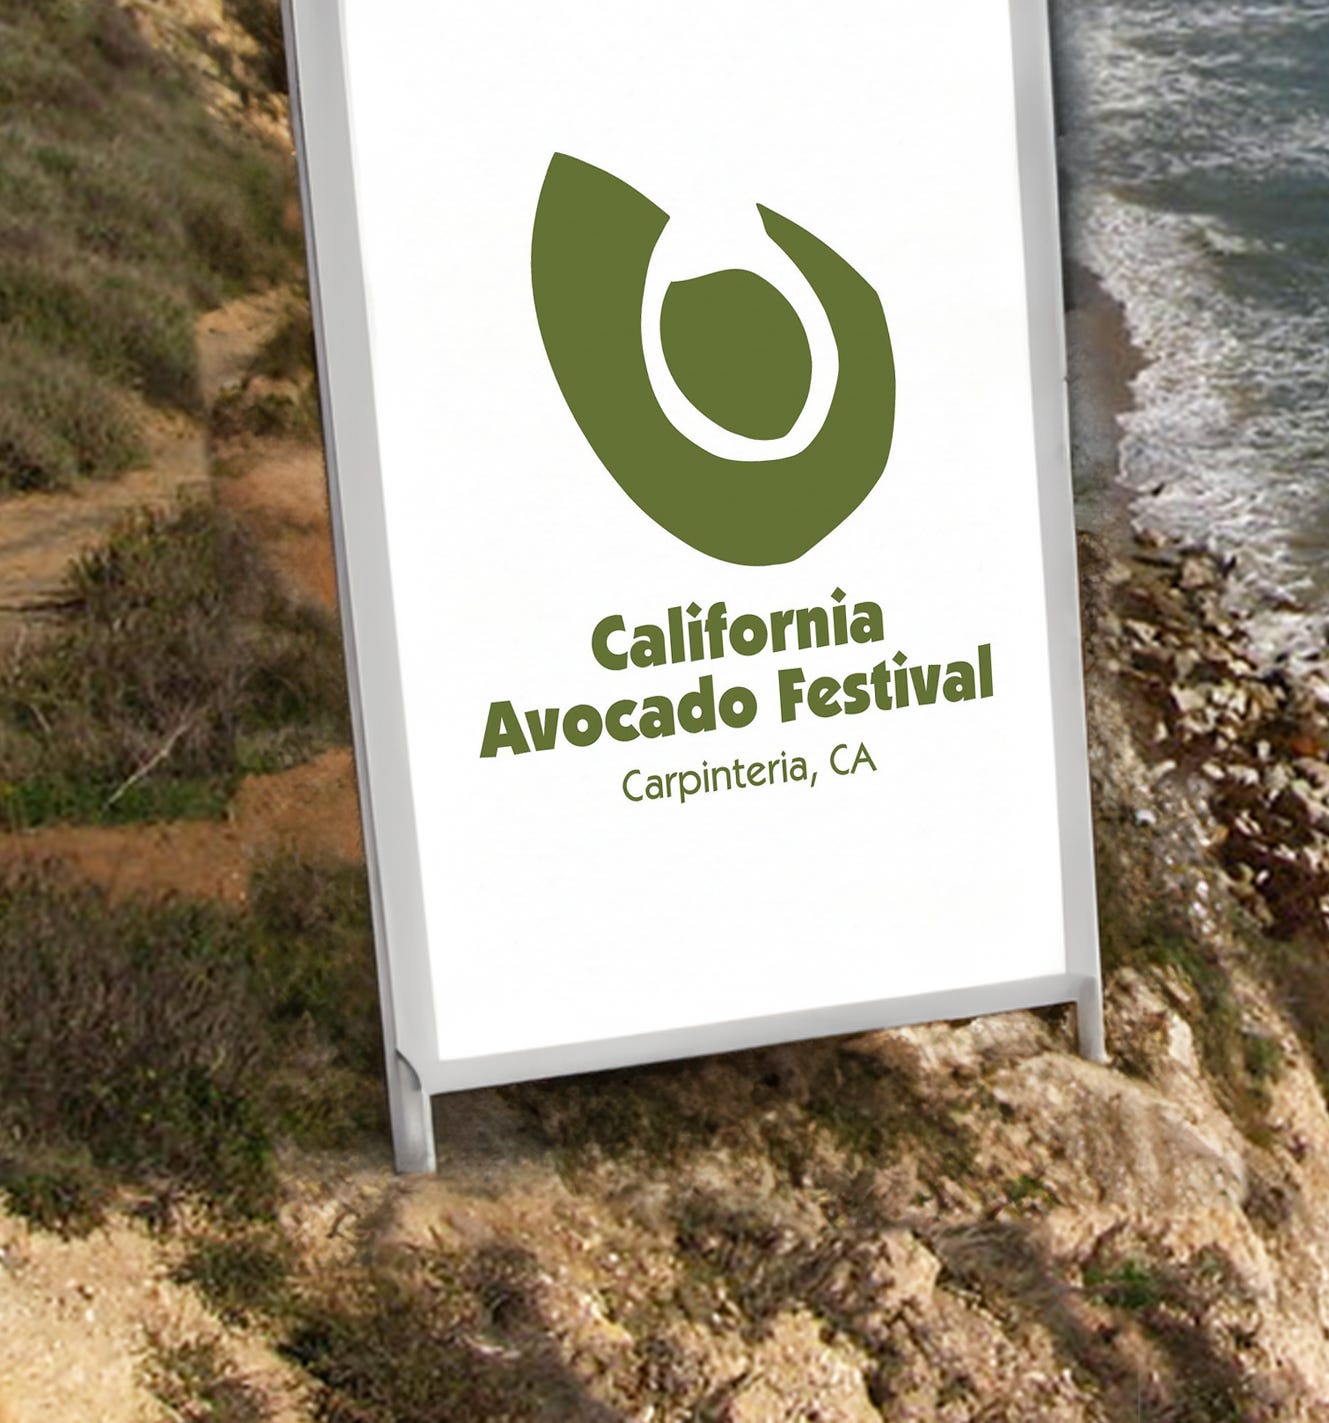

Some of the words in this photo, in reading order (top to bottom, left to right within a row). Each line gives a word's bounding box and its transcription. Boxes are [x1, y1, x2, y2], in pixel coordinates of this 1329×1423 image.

[591, 586, 885, 671] California
[479, 674, 758, 759] Avocado
[778, 643, 994, 723] Festival
[622, 750, 818, 804] Carpinteria,
[830, 741, 878, 776] CA
